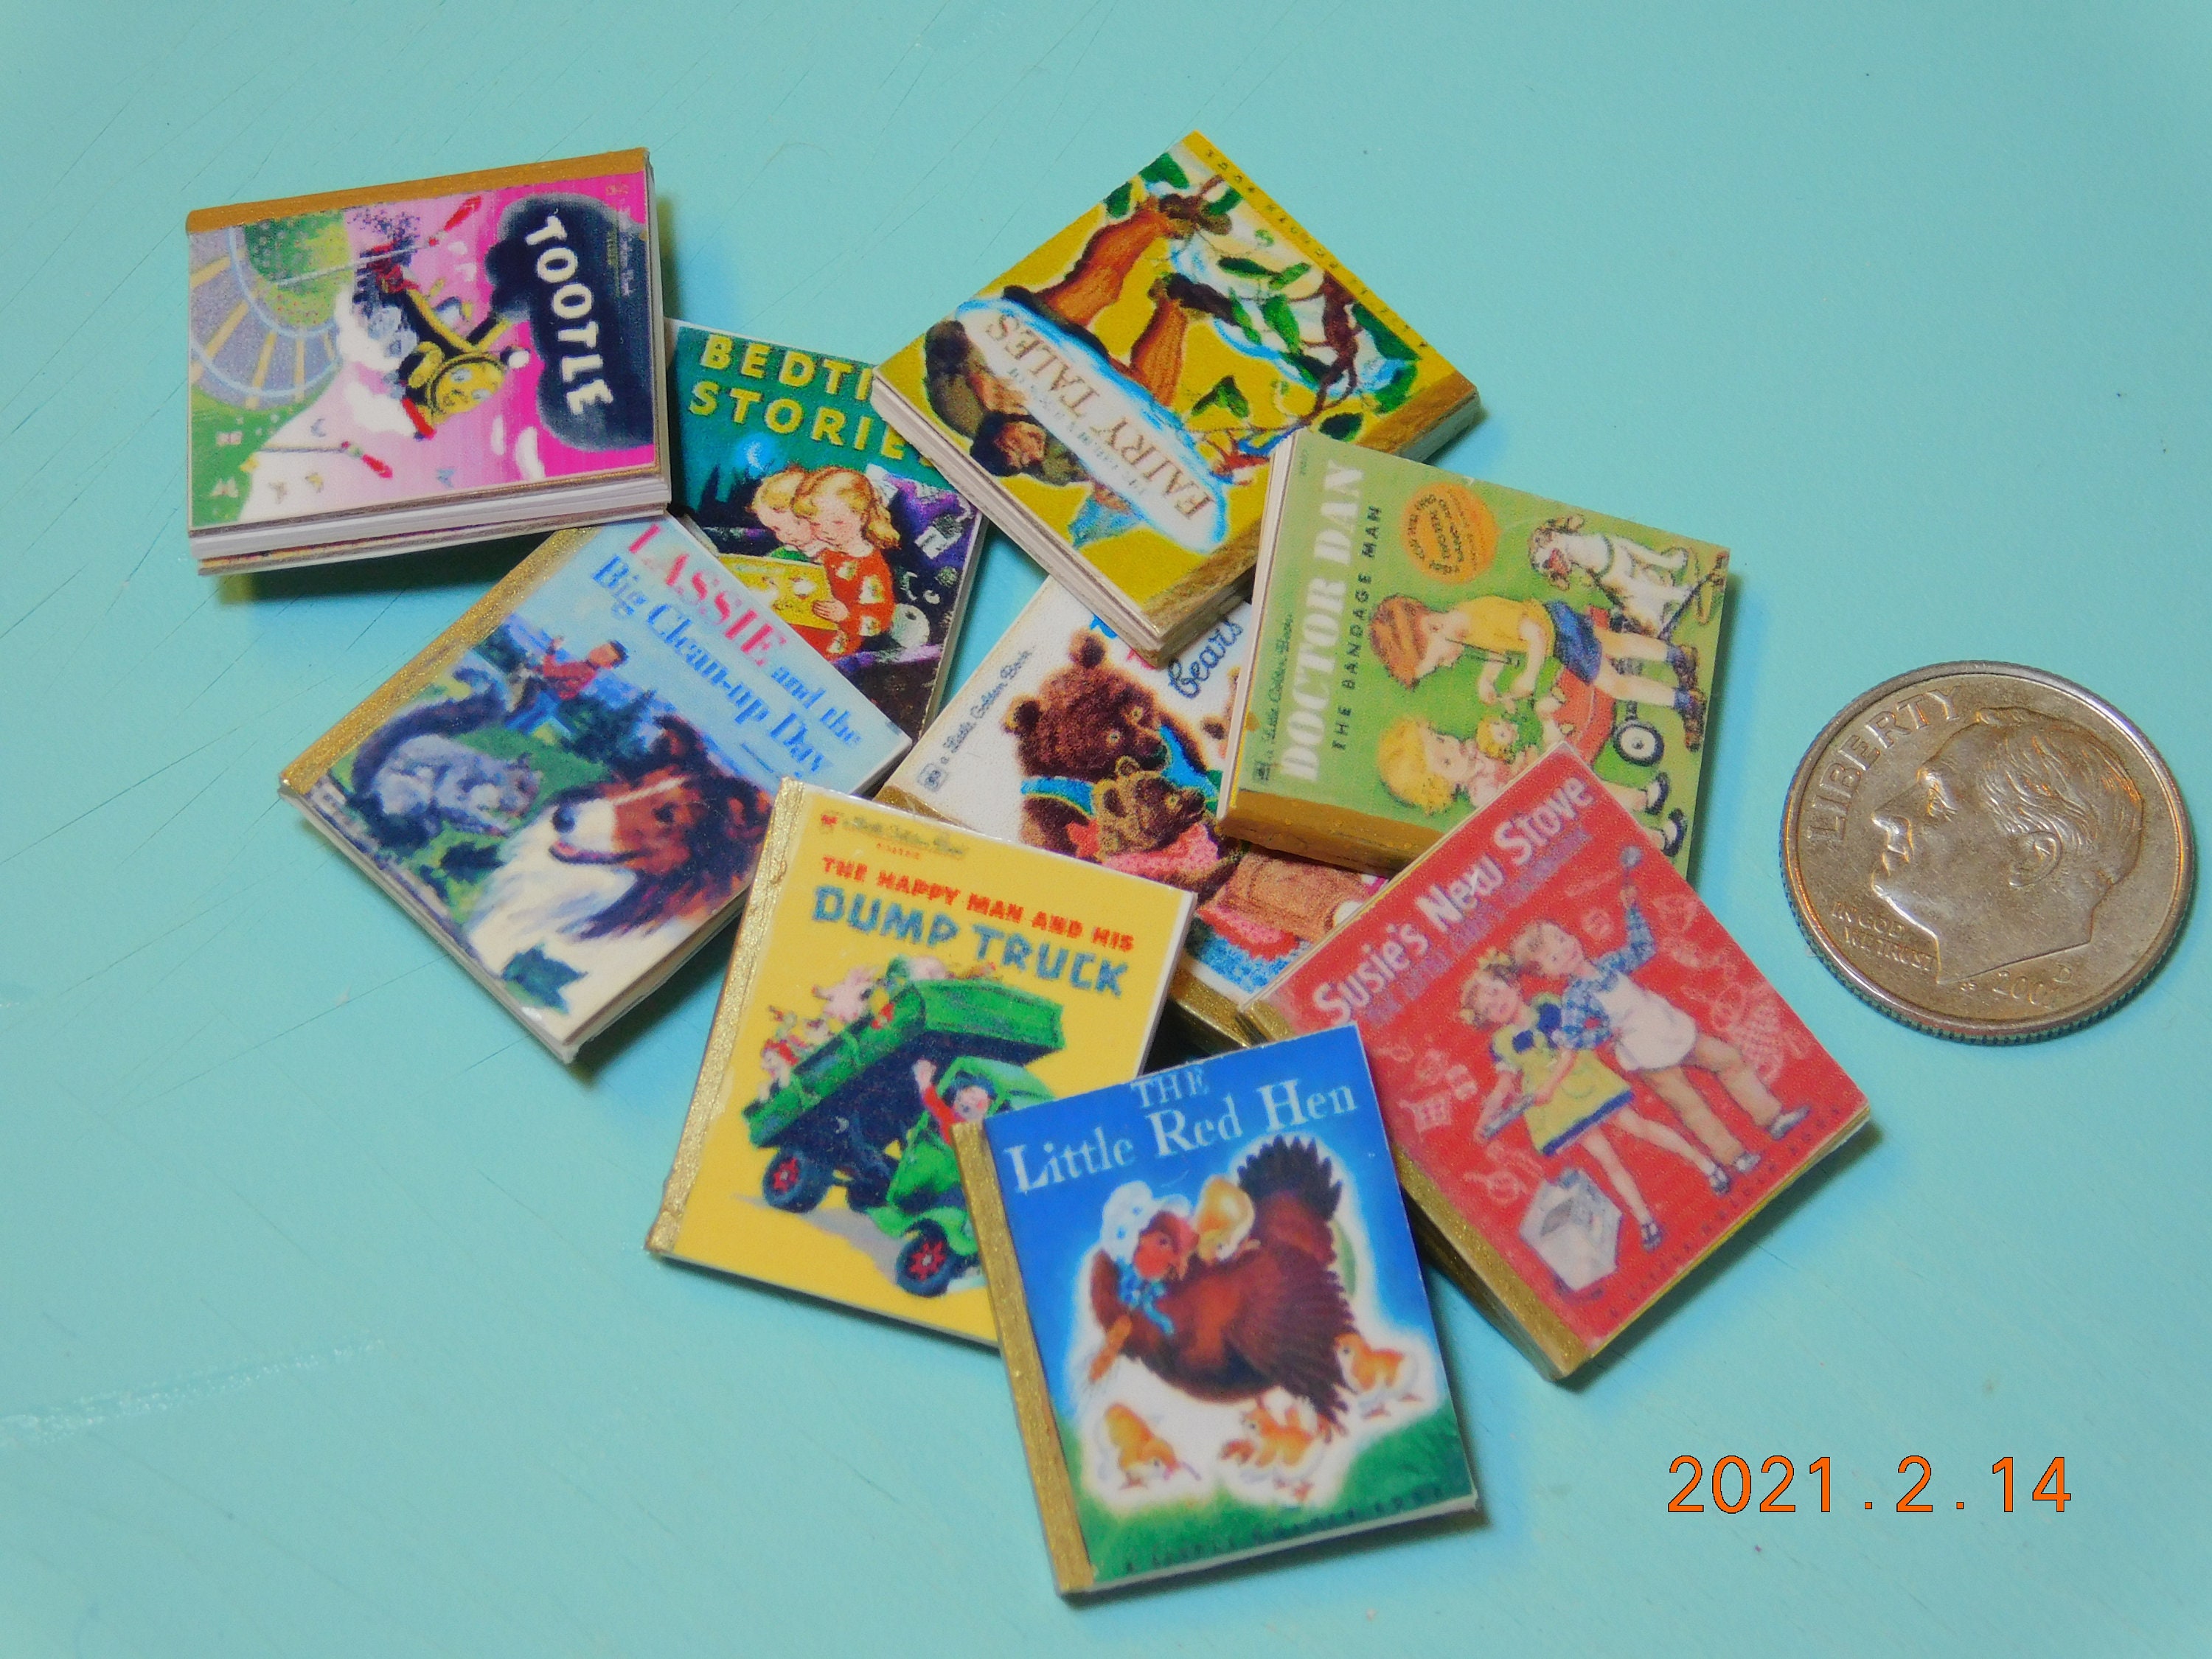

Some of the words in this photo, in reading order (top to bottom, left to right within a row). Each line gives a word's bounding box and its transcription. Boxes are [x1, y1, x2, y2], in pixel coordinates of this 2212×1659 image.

[525, 215, 613, 414] TOOTLE
[700, 334, 873, 401] BEDTI
[986, 313, 1100, 418] TALES
[689, 380, 933, 467] STORIE
[1089, 418, 1215, 520] FAIRY
[1313, 459, 1364, 566] DAN
[1360, 505, 1382, 558] MAN
[593, 554, 647, 620] Big
[646, 603, 771, 725] Clean-up
[769, 712, 833, 779] Day
[628, 523, 787, 667] LASSIE
[771, 666, 827, 710] and
[819, 706, 862, 747] the
[1281, 577, 1347, 782] DOCTOR
[1341, 572, 1371, 690] BANDAGE
[1332, 706, 1352, 751] THE
[1806, 685, 1962, 844] LIBERTY
[812, 884, 959, 949] DUMP
[971, 923, 1129, 998] TRUCK
[821, 855, 868, 883] THE
[877, 869, 961, 906] HAPPY
[966, 891, 1024, 924] MAN
[1032, 910, 1084, 939] AND
[1091, 925, 1135, 952] HIS
[1312, 922, 1430, 1025] Susie's
[1414, 852, 1506, 933] New
[1493, 776, 1594, 866] Stove
[1004, 1125, 1135, 1194] Little
[1145, 1093, 1243, 1158] Red
[1256, 1078, 1358, 1133] Hen
[1130, 1063, 1211, 1108] THE
